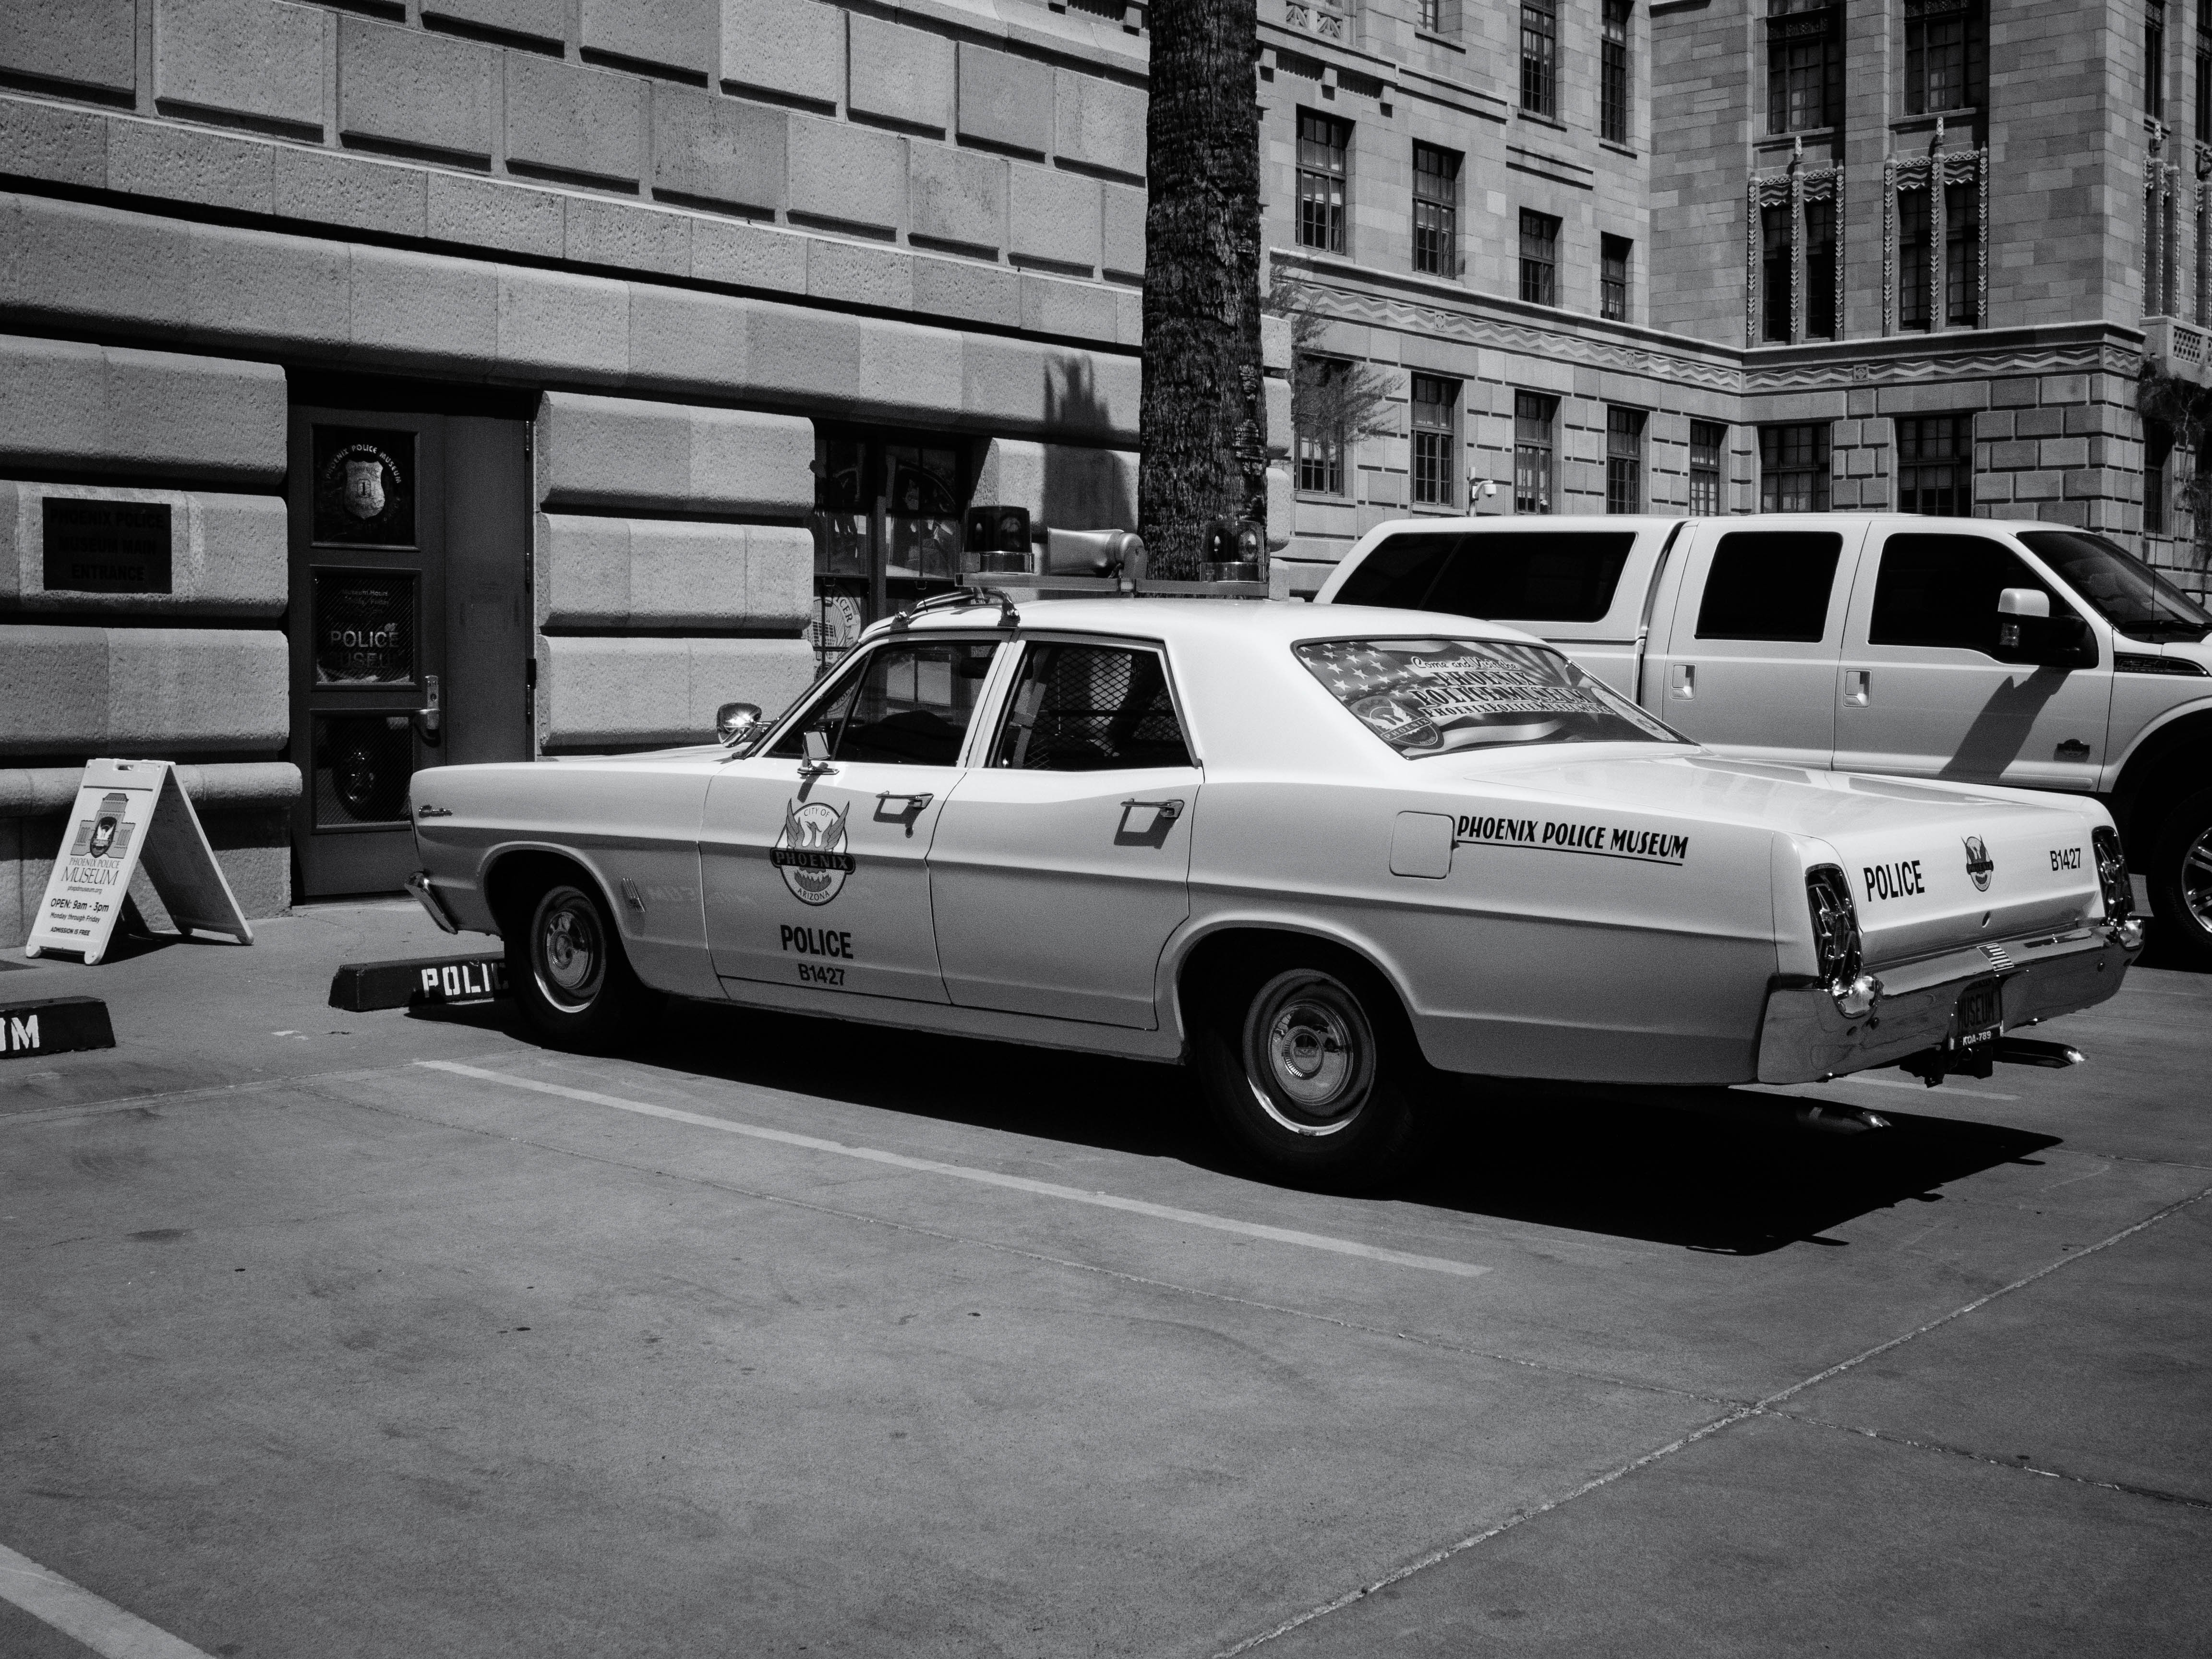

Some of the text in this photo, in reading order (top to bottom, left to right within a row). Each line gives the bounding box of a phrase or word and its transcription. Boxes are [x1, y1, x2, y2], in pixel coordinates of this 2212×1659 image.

[326, 444, 401, 483] PHOENIX POLICE MUSEUM
[51, 509, 164, 528] PHOENIX POLICE
[59, 537, 156, 554] MUSEUM MAIN
[72, 565, 144, 581] ENTRANCE
[331, 630, 399, 648] POLICE
[323, 652, 408, 669] USEU
[1412, 656, 1519, 670] Come and Visit the
[1431, 672, 1540, 686] PHOENIX
[1408, 686, 1595, 706] POLICE MUSEUM
[1384, 719, 1430, 739] PHOENIX
[804, 807, 830, 817] CITY OF
[1457, 815, 1689, 859] PHOENIX POLICE MUSEUM
[69, 857, 120, 869] PHOENIX POLICE
[776, 851, 848, 869] PHOENIX
[2050, 848, 2080, 871] B1427
[61, 866, 119, 886] MUSEUM
[1863, 860, 1925, 902] POLICE
[797, 888, 830, 901] ARIZONA
[50, 898, 72, 908] OPEN:
[72, 900, 87, 910] 9am
[93, 902, 109, 913] 3pm
[50, 912, 101, 924] Monday through Friday
[780, 925, 854, 959] POLICE
[798, 963, 845, 986] B1427
[1958, 992, 1994, 1030] MUSEUM
[1963, 1031, 1991, 1046] KOA-789
